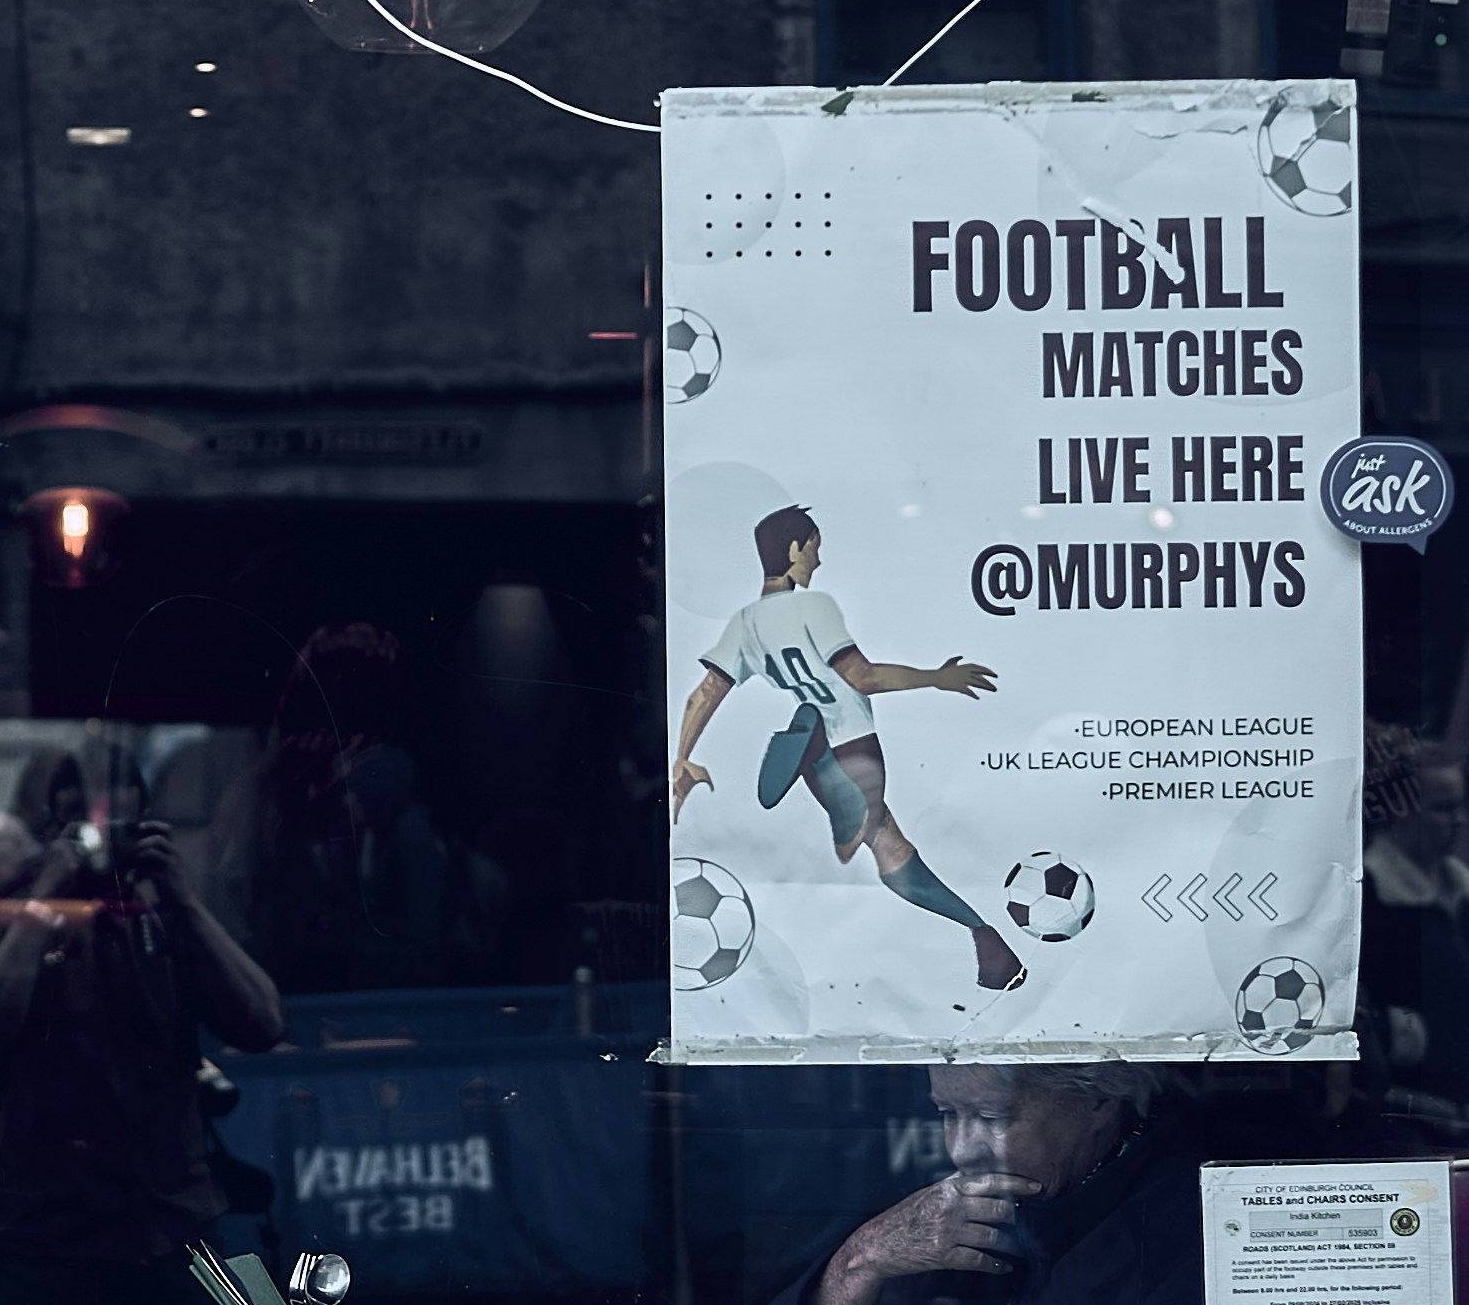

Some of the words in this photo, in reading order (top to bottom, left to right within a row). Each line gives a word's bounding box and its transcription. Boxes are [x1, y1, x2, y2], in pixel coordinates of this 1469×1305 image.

[911, 216, 1284, 312] FOOTBALL
[1042, 328, 1304, 399] MATCHES
[1039, 438, 1151, 505] LIVE
[1172, 435, 1304, 503] HERE
[1351, 454, 1386, 478] just
[1342, 460, 1430, 515] ask
[1343, 520, 1377, 534] ABOUT
[1379, 518, 1432, 534] ALLERGENS
[970, 540, 1306, 617] @MURPHYS
[1082, 718, 1214, 738] EUROPEAN
[1221, 716, 1314, 737] LEAGUE
[987, 752, 1020, 771] UK
[1028, 750, 1121, 770] LEAGUE
[1128, 748, 1315, 769] CHAMPIONSHIP
[1109, 781, 1215, 801] PREMIER
[1221, 779, 1315, 799] LEAGUE
[1289, 1184, 1336, 1192] EDINBURGH
[1339, 1183, 1374, 1191] COUNCIL
[1242, 1197, 1282, 1206] TABLES
[1286, 1196, 1303, 1204] and
[1307, 1195, 1346, 1204] CHAIRS
[1350, 1194, 1399, 1203] CONSENT
[1251, 1230, 1285, 1238] CONSENT
